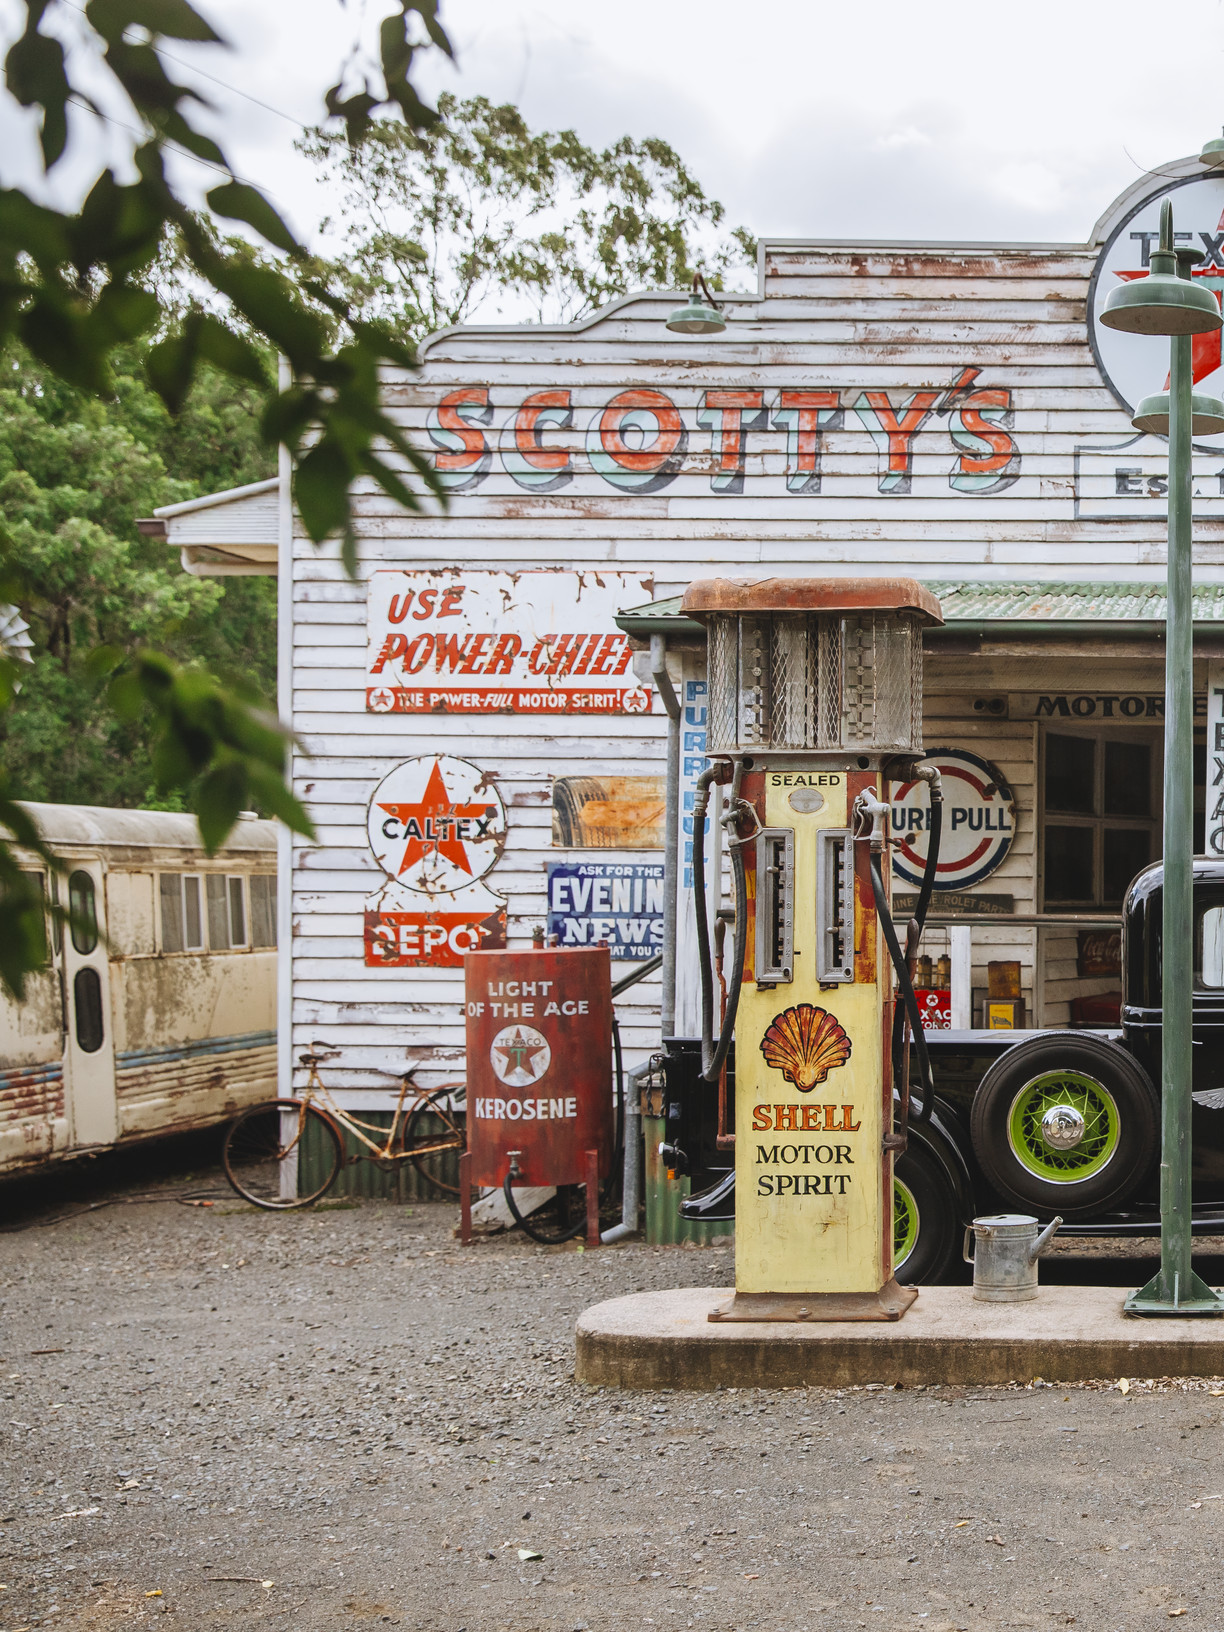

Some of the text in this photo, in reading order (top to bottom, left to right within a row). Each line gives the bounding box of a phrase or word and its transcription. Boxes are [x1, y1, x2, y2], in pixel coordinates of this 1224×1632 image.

[428, 366, 1022, 496] SCOTTY'S
[1115, 468, 1202, 495] Es.
[388, 586, 466, 624] USE
[397, 689, 621, 708] THE POWER-FULL MOTOR SPIRIT!
[1034, 696, 1165, 717] MOTOR
[772, 775, 840, 786] SEALED
[382, 817, 492, 841] CALTEX
[892, 808, 1011, 830] UR PULL
[578, 866, 662, 877] ASK FOR THE
[552, 877, 664, 913] EVENIN
[563, 918, 664, 943] NEWS
[630, 946, 651, 956] YOU
[488, 981, 553, 997] LIGHT
[468, 1000, 589, 1018] OF THE AGE
[500, 1038, 541, 1046] TEXACO
[475, 1097, 577, 1120] KEROSENE
[752, 1104, 861, 1131] SHELL
[755, 1145, 855, 1164] MOTOR
[757, 1175, 851, 1196] SPIRIT
